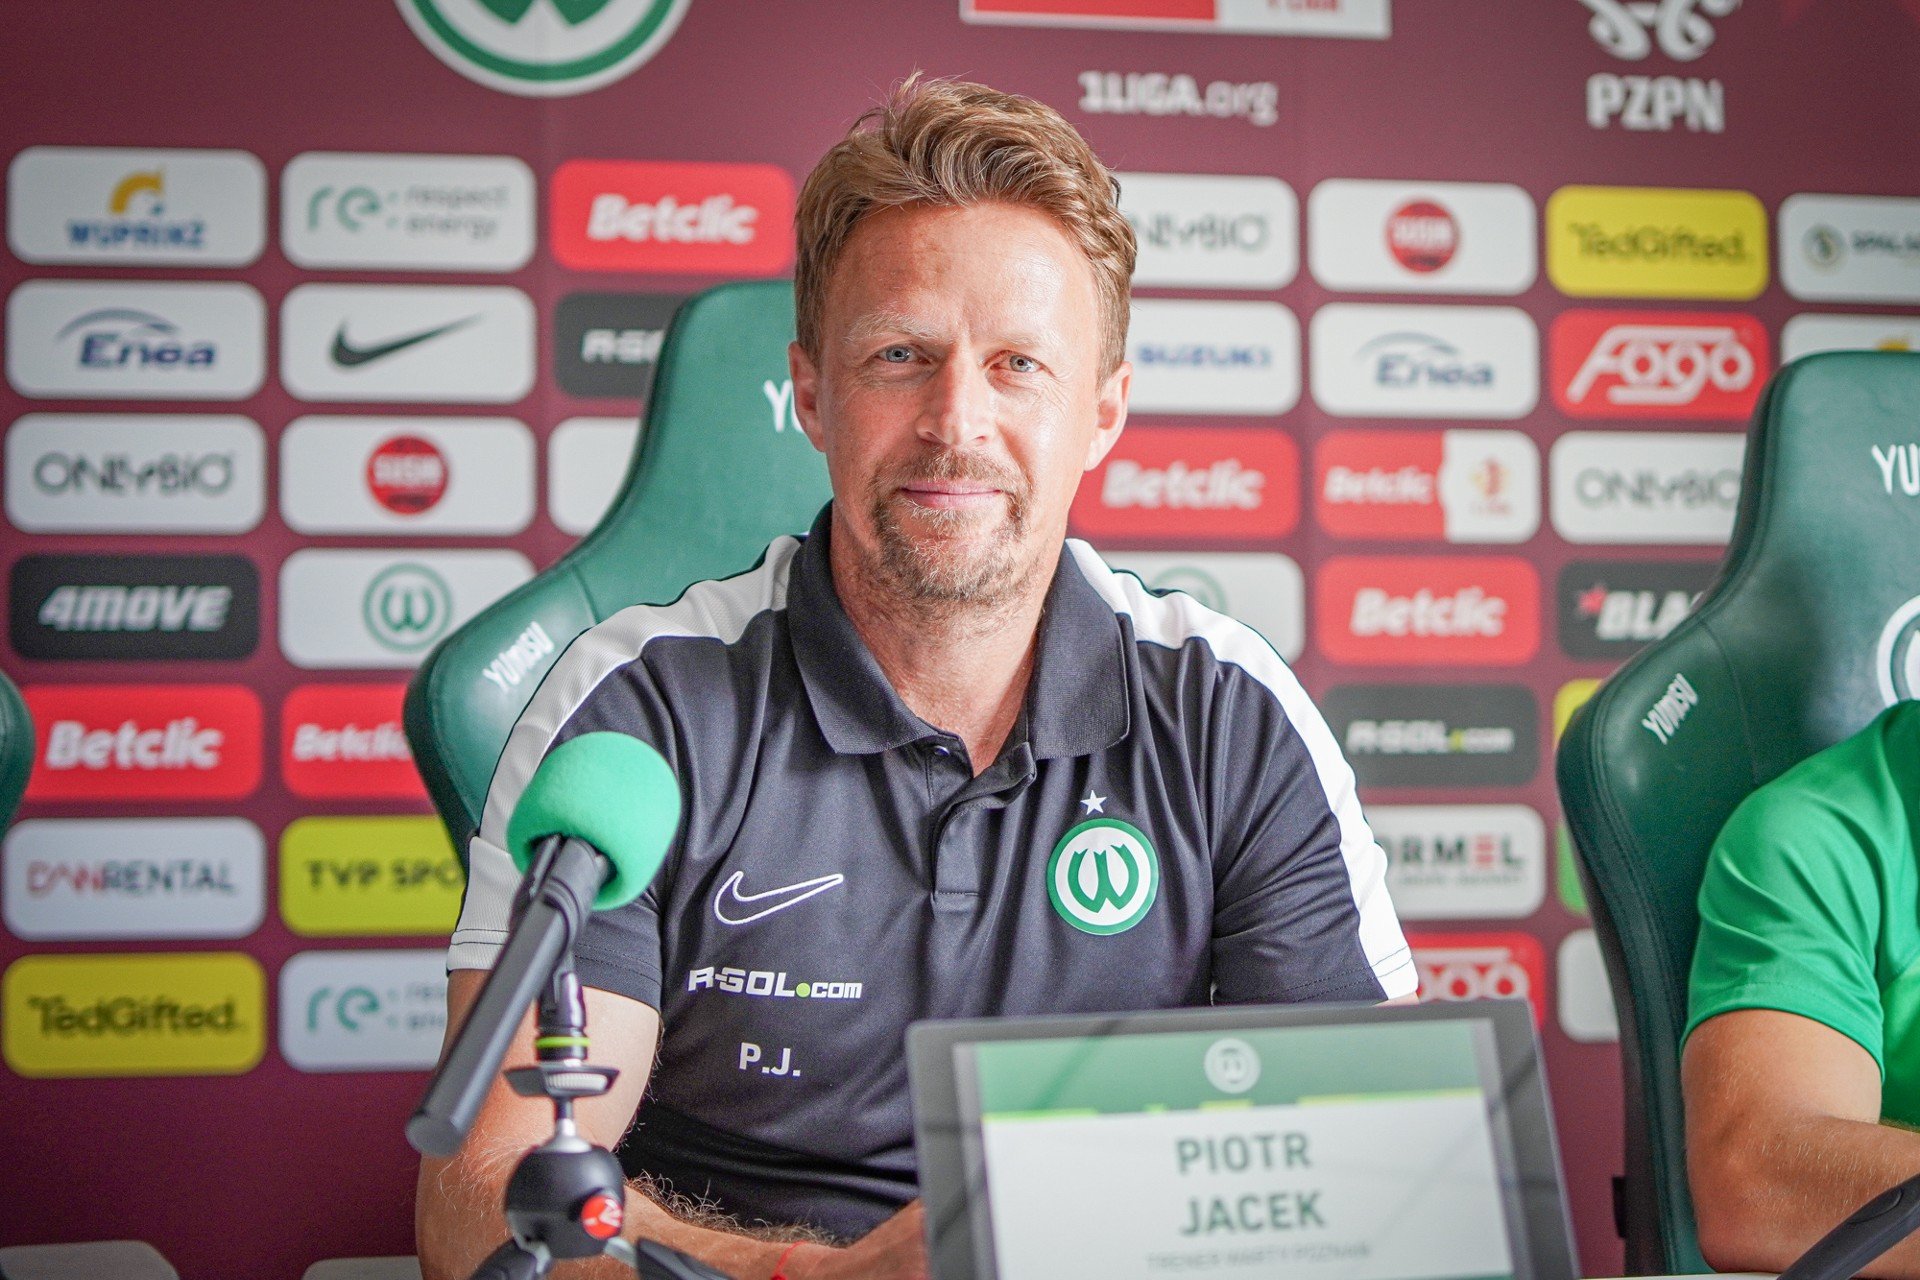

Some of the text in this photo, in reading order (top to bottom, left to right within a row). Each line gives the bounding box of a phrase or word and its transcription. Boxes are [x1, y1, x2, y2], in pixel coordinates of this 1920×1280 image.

[1586, 73, 1726, 134] PZPN
[587, 193, 760, 243] Betclic
[1102, 458, 1265, 510] Betclic
[1324, 466, 1434, 504] Betclic
[1350, 586, 1507, 638] Betclic
[46, 718, 224, 769] Betclic
[739, 1042, 801, 1078] P.J.
[1176, 1133, 1312, 1175] PIOTR
[1180, 1193, 1326, 1236] JACEK
